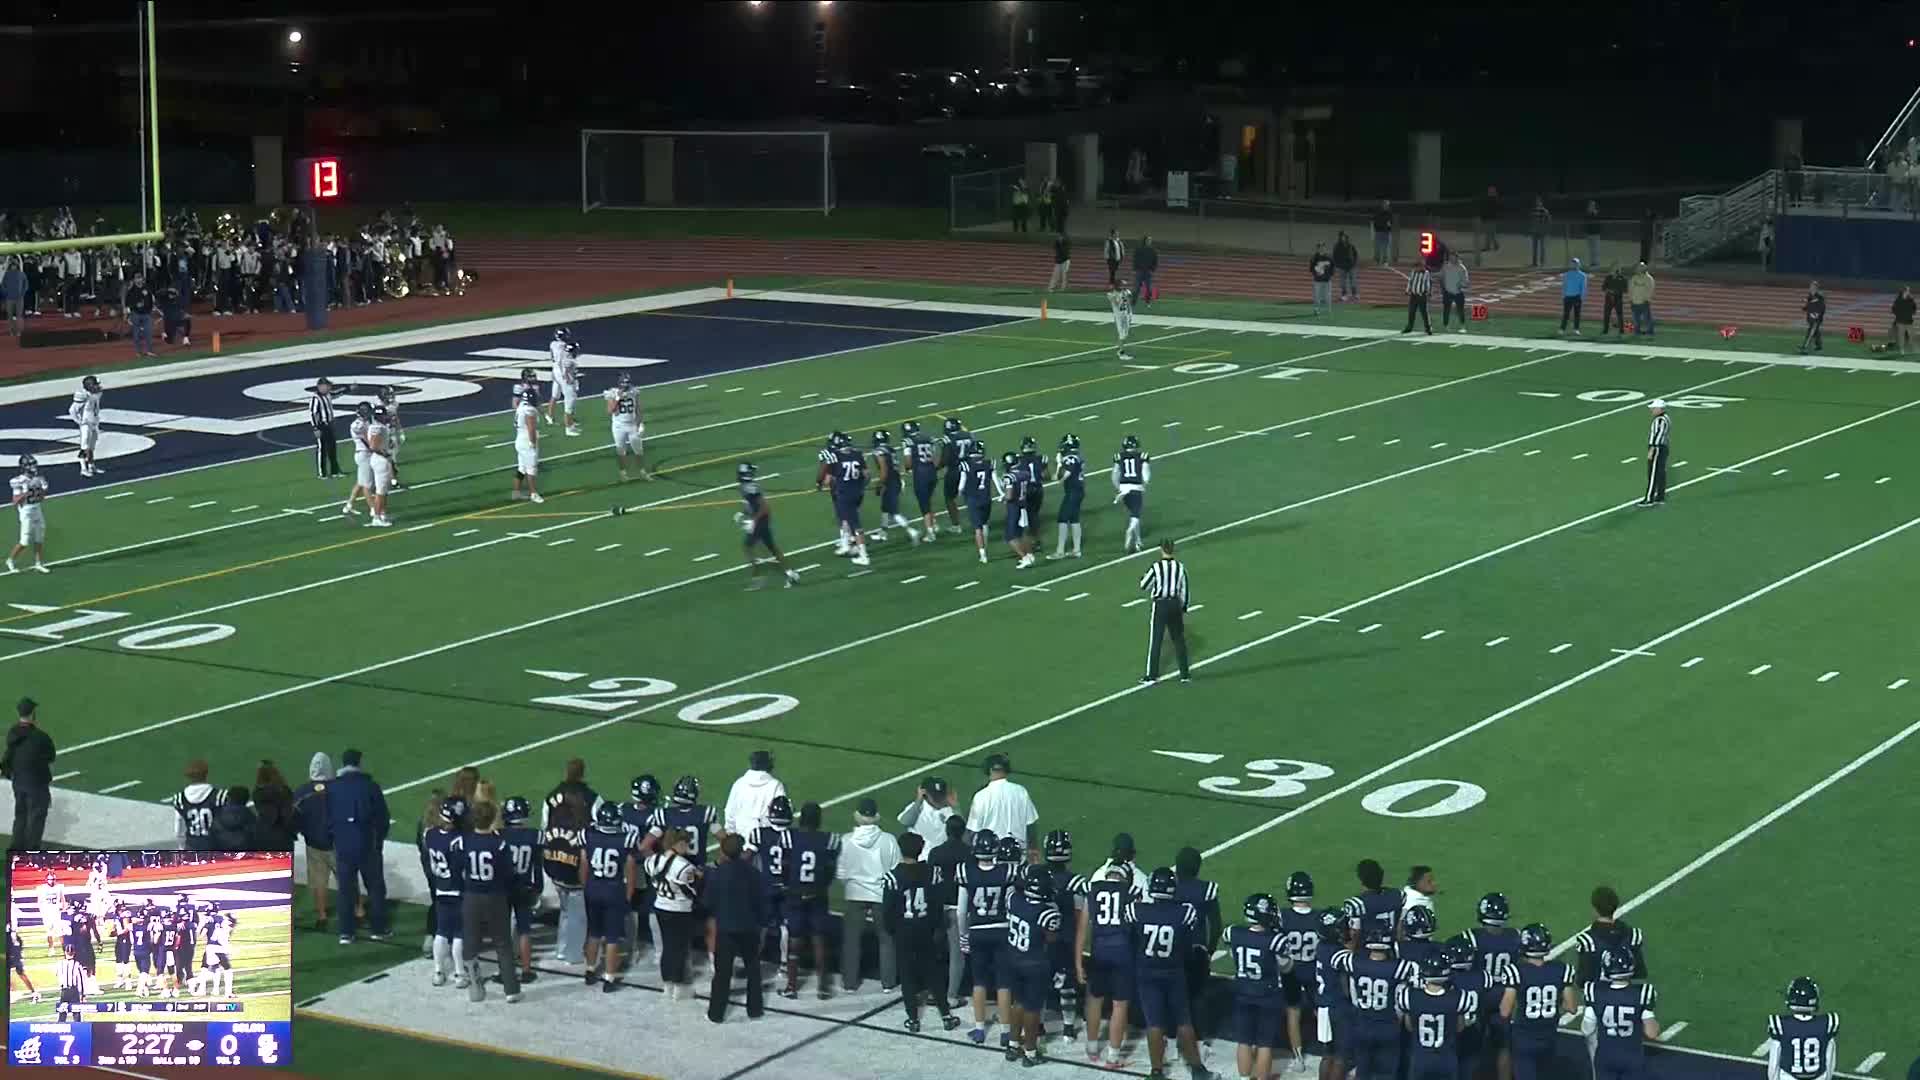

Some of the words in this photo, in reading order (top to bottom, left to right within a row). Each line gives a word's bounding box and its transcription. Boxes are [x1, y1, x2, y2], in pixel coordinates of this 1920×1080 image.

[314, 161, 338, 197] 13
[1421, 232, 1433, 253] 3
[1472, 305, 1488, 318] 10
[841, 461, 861, 481] 76
[976, 471, 986, 489] 7
[1123, 458, 1137, 477] 11
[529, 677, 800, 725] 20
[1198, 759, 1487, 818] 30
[468, 852, 494, 881] 16
[590, 848, 619, 878] 46
[769, 846, 783, 875] 3
[800, 851, 816, 883] 2
[903, 887, 928, 919] 14
[973, 886, 1001, 917] 47
[1095, 891, 1121, 925] 31
[1008, 915, 1031, 952] 58
[1143, 924, 1174, 958] 79
[1286, 931, 1319, 962] 22
[1236, 946, 1262, 980] 15
[1357, 976, 1389, 1011] 38
[1525, 985, 1558, 1019] 88
[1418, 1013, 1445, 1048] 61
[1602, 1005, 1636, 1037] 45
[59, 1035, 76, 1056] 7
[122, 1034, 175, 1055] 2:27
[221, 1034, 238, 1055] 0
[1790, 1037, 1821, 1073] 18
